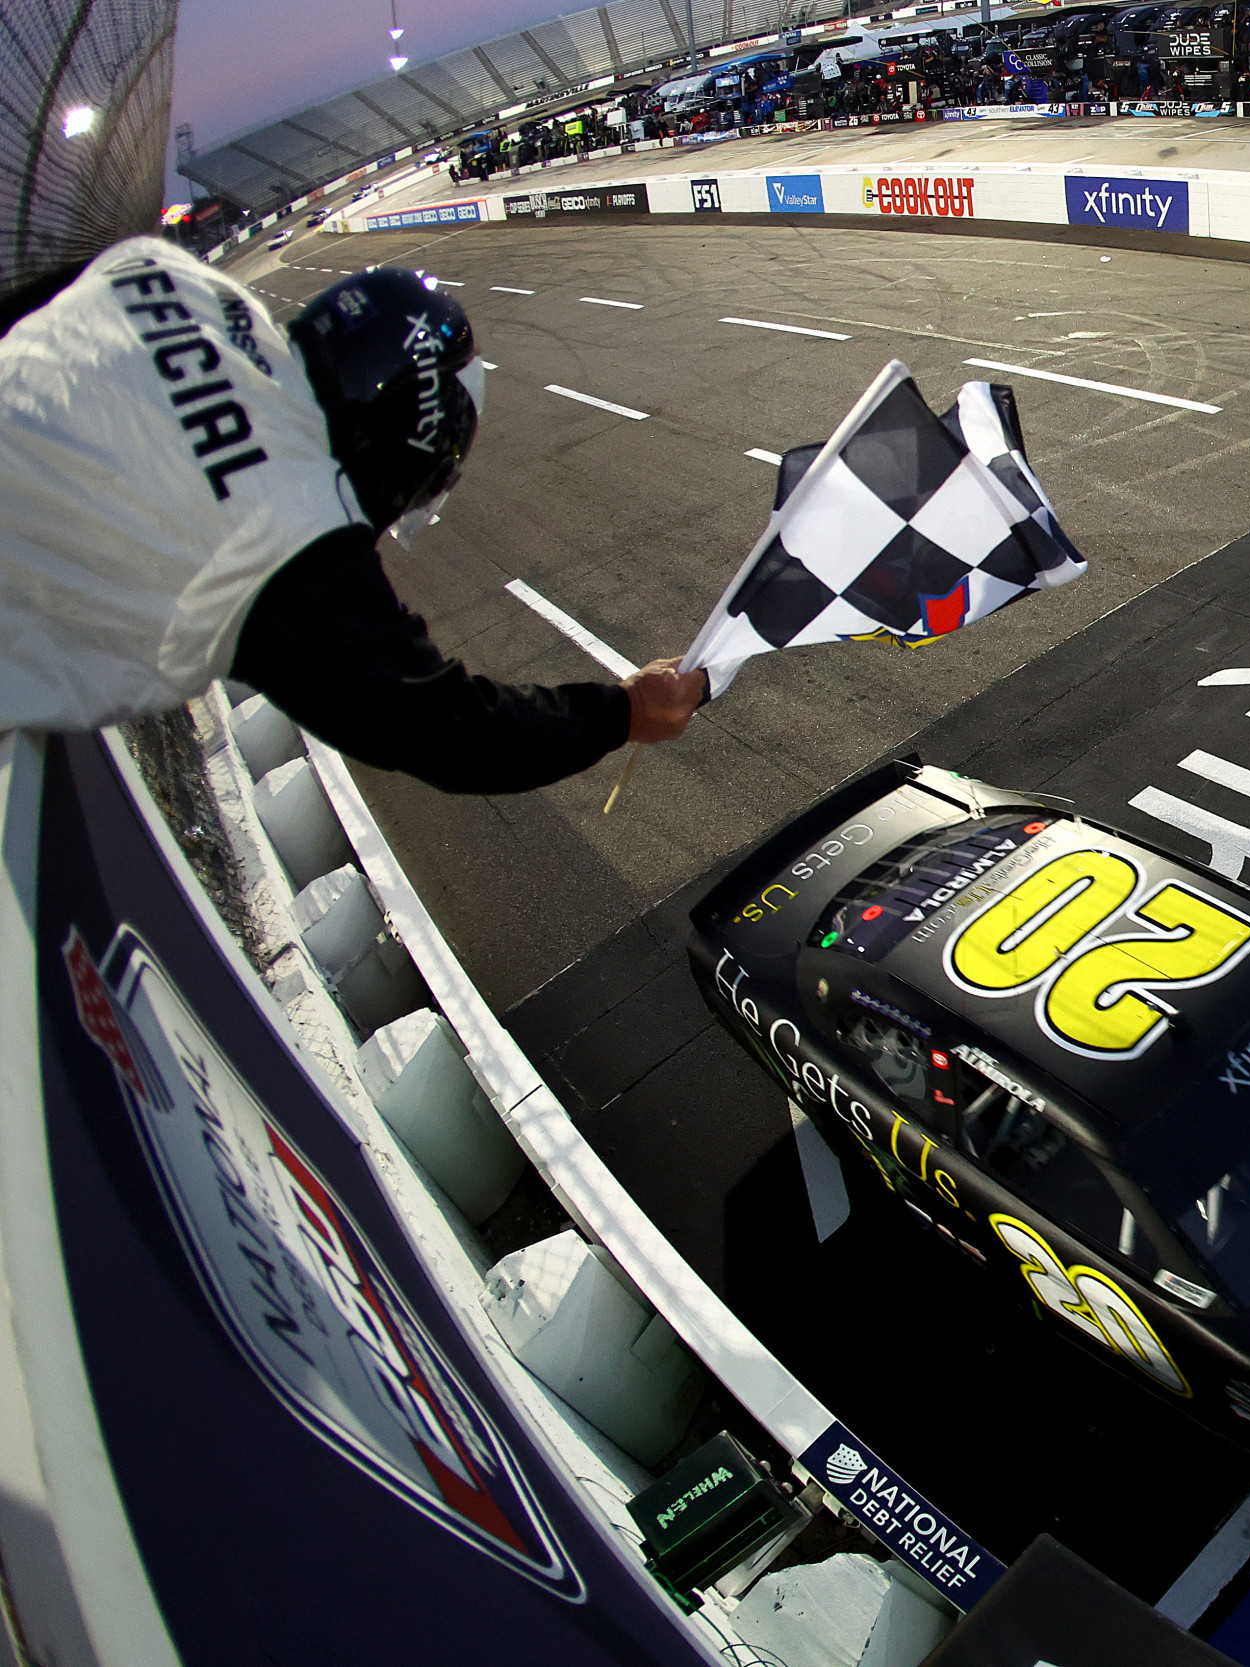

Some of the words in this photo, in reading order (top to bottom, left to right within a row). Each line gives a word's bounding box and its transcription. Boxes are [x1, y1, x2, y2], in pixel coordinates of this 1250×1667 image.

[1169, 33, 1211, 46] DUDE
[1170, 46, 1211, 56] WIPES
[897, 64, 916, 72] TOYOTA
[1024, 59, 1052, 68] COLLISION
[881, 113, 899, 121] TOYOTA
[1048, 104, 1060, 115] 43
[561, 196, 586, 211] GEICO
[612, 194, 636, 206] PLAYOFFS
[694, 180, 719, 209] FS1
[784, 192, 818, 207] ValleyStar
[878, 177, 933, 216] COOK
[933, 178, 974, 217] OUT
[1083, 182, 1174, 228] xfinity
[106, 259, 269, 502] FFICIAL
[402, 312, 448, 453] xfinity
[792, 824, 875, 880] Gets
[903, 838, 1018, 922] ALMIROLA
[715, 947, 763, 1037] He
[769, 1018, 874, 1142] Gets
[950, 1044, 1047, 1113] ALMIROLA
[174, 1030, 318, 1368] NATIONAL
[268, 1150, 483, 1493] 250
[656, 1465, 734, 1530] WHELEN
[849, 1488, 902, 1534] DEBT
[898, 1529, 967, 1592] RELIEF
[861, 1467, 982, 1580] NATIONAL
